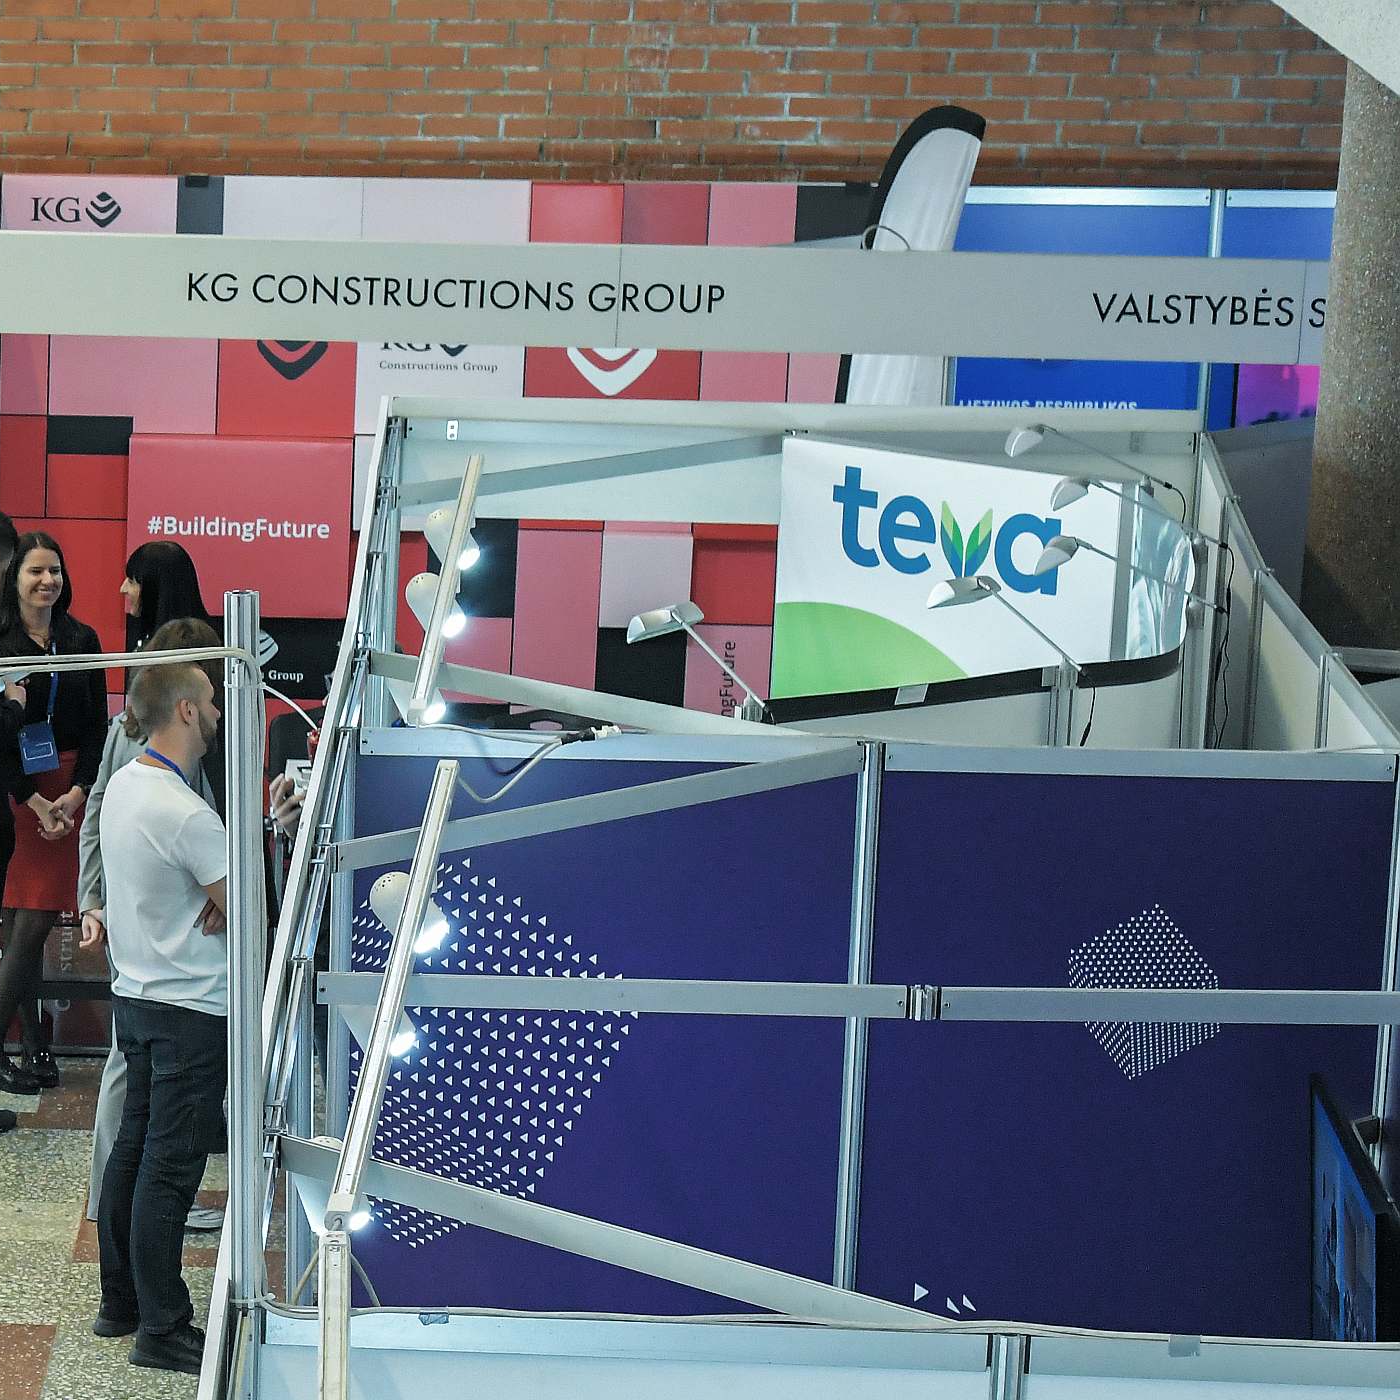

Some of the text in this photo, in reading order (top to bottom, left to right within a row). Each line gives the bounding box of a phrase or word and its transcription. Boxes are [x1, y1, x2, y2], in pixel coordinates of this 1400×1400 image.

[30, 196, 82, 223] KG
[186, 272, 726, 314] KG CONSTRUCTIONS GROUP
[1091, 287, 1295, 329] VALSTYBĖS
[379, 360, 498, 373] Constructions Group
[147, 516, 331, 542] #BuildingFuture
[832, 465, 1062, 596] teva
[267, 669, 305, 682] Group
